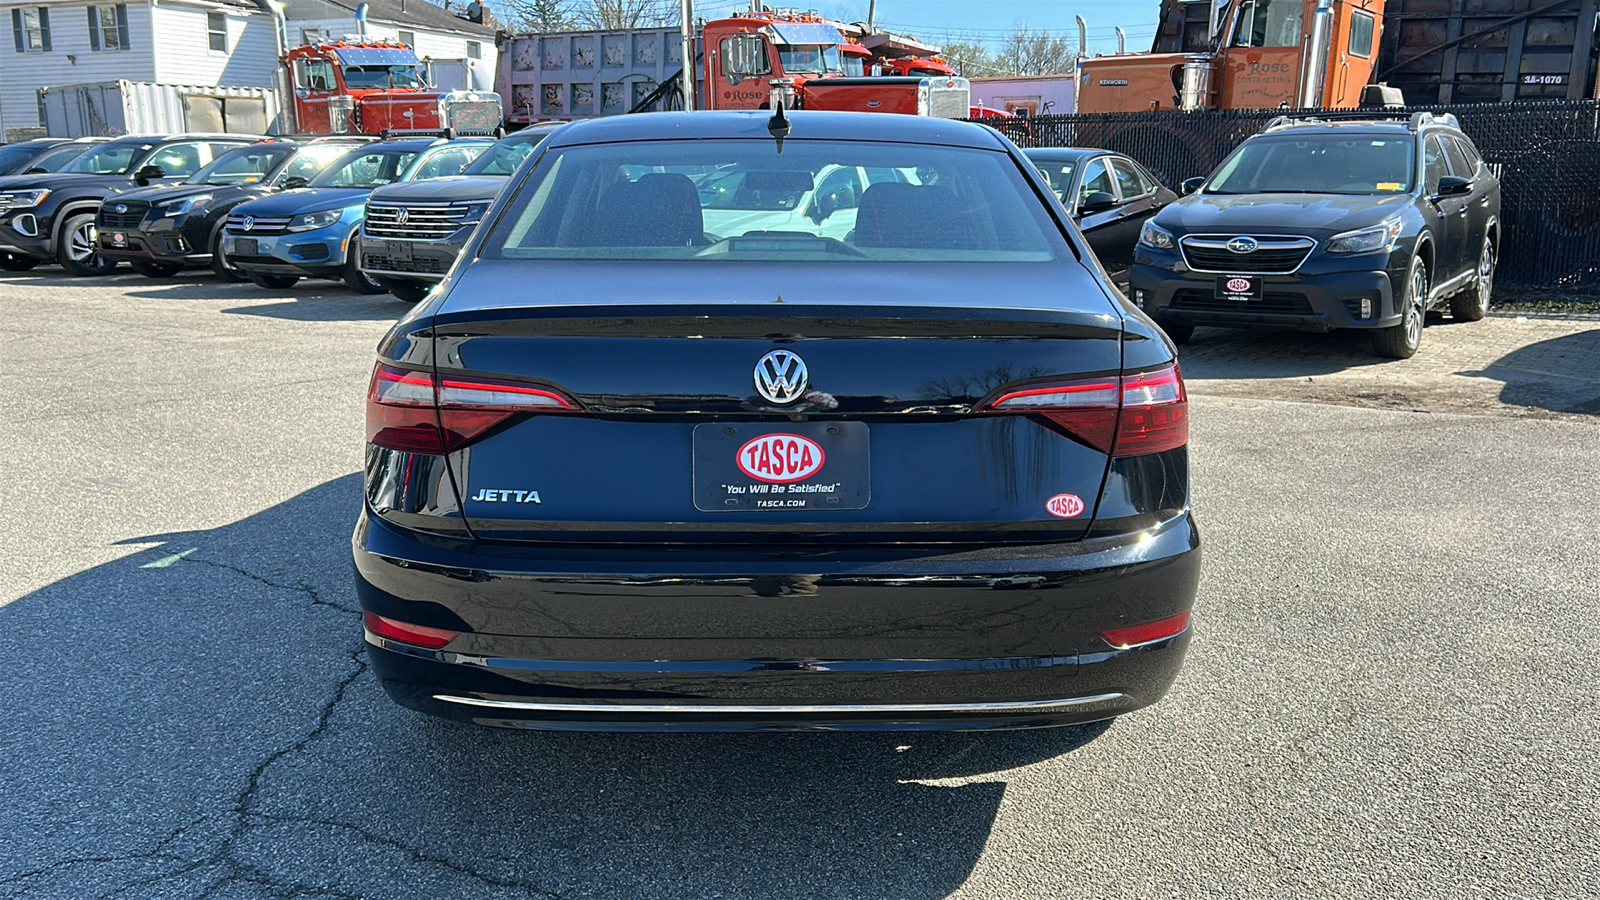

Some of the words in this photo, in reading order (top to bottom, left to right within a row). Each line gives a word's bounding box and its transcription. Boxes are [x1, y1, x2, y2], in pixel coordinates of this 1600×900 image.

[1248, 62, 1289, 75] Rose
[1236, 76, 1291, 84] CONTRACTING
[1524, 75, 1562, 84] 3A-1070
[731, 91, 762, 102] Rose
[1229, 280, 1248, 290] TASCA
[747, 439, 814, 477] TASCA
[749, 484, 768, 494] Will
[771, 484, 786, 493] Be
[472, 488, 542, 503] JETTA
[756, 500, 806, 508] TASCA.COM
[1051, 497, 1079, 515] TASCA
